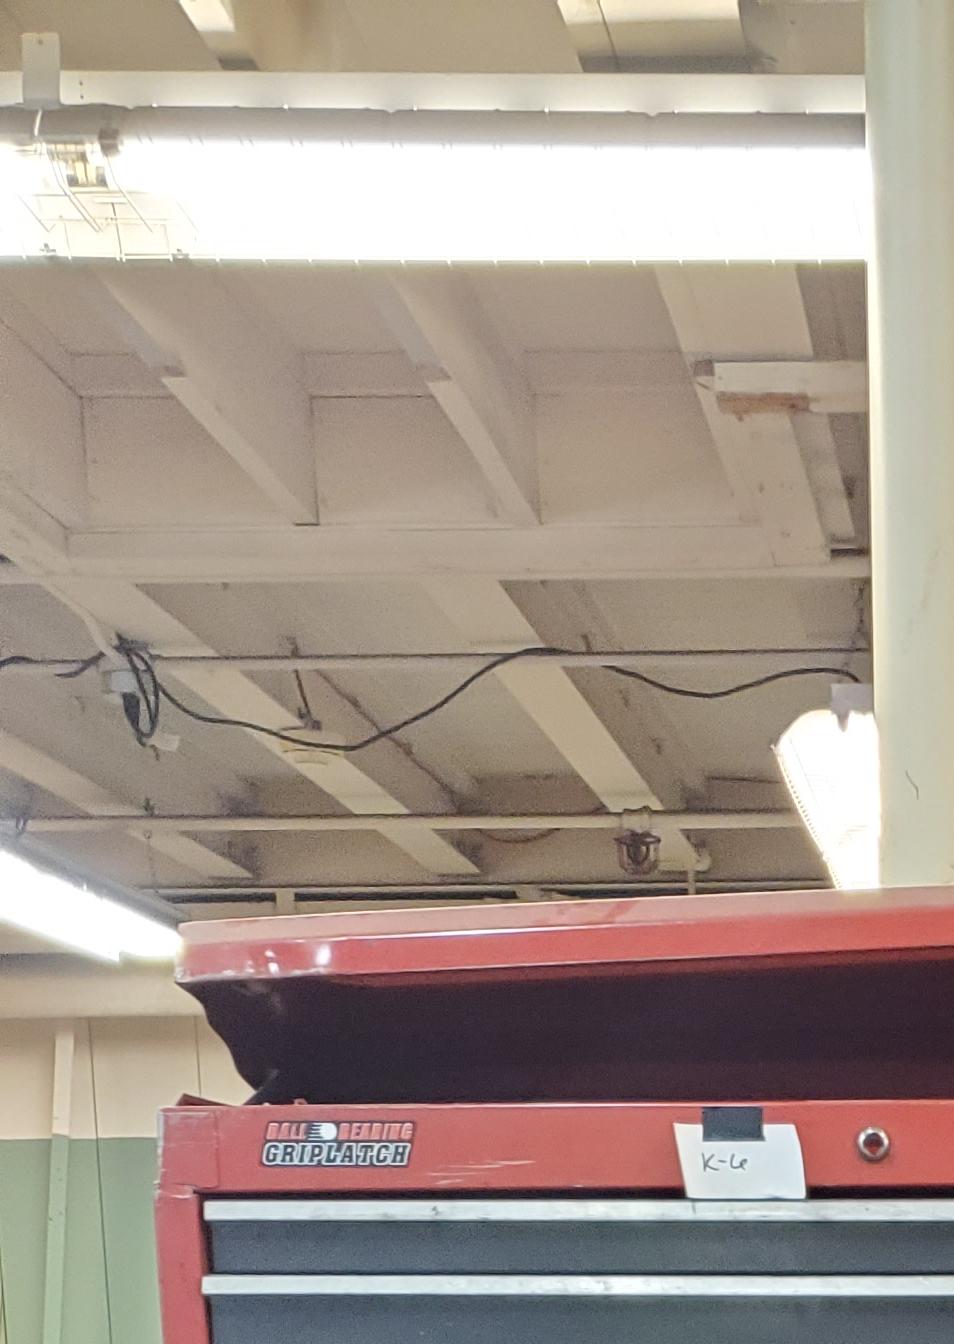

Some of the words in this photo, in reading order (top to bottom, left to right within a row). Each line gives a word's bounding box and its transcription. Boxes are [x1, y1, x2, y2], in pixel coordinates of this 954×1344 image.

[265, 1121, 307, 1140] BALL
[338, 1121, 414, 1140] BEARING
[262, 1142, 411, 1166] GRIPLATCH
